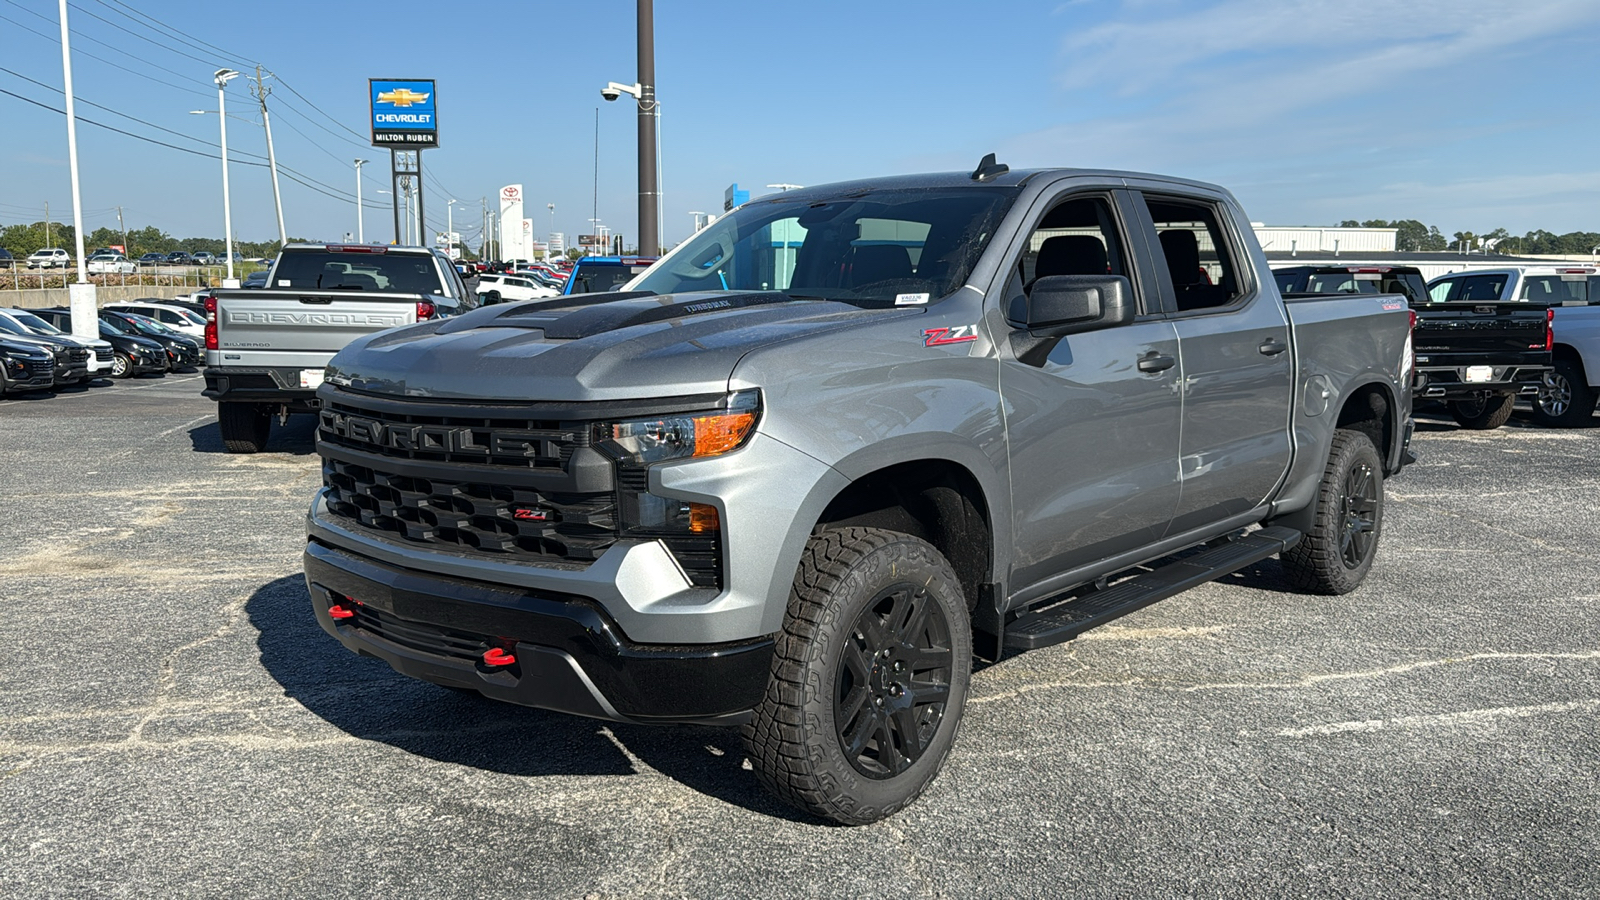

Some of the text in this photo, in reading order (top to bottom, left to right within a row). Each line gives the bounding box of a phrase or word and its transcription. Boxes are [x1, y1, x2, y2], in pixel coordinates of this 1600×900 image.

[376, 114, 431, 123] CHEVROLET
[684, 300, 731, 313] TURBOMAX
[229, 312, 403, 326] CHEVROLET
[920, 324, 978, 347] Z71
[319, 410, 574, 460] CHEVROLET
[514, 508, 547, 520] Z71
